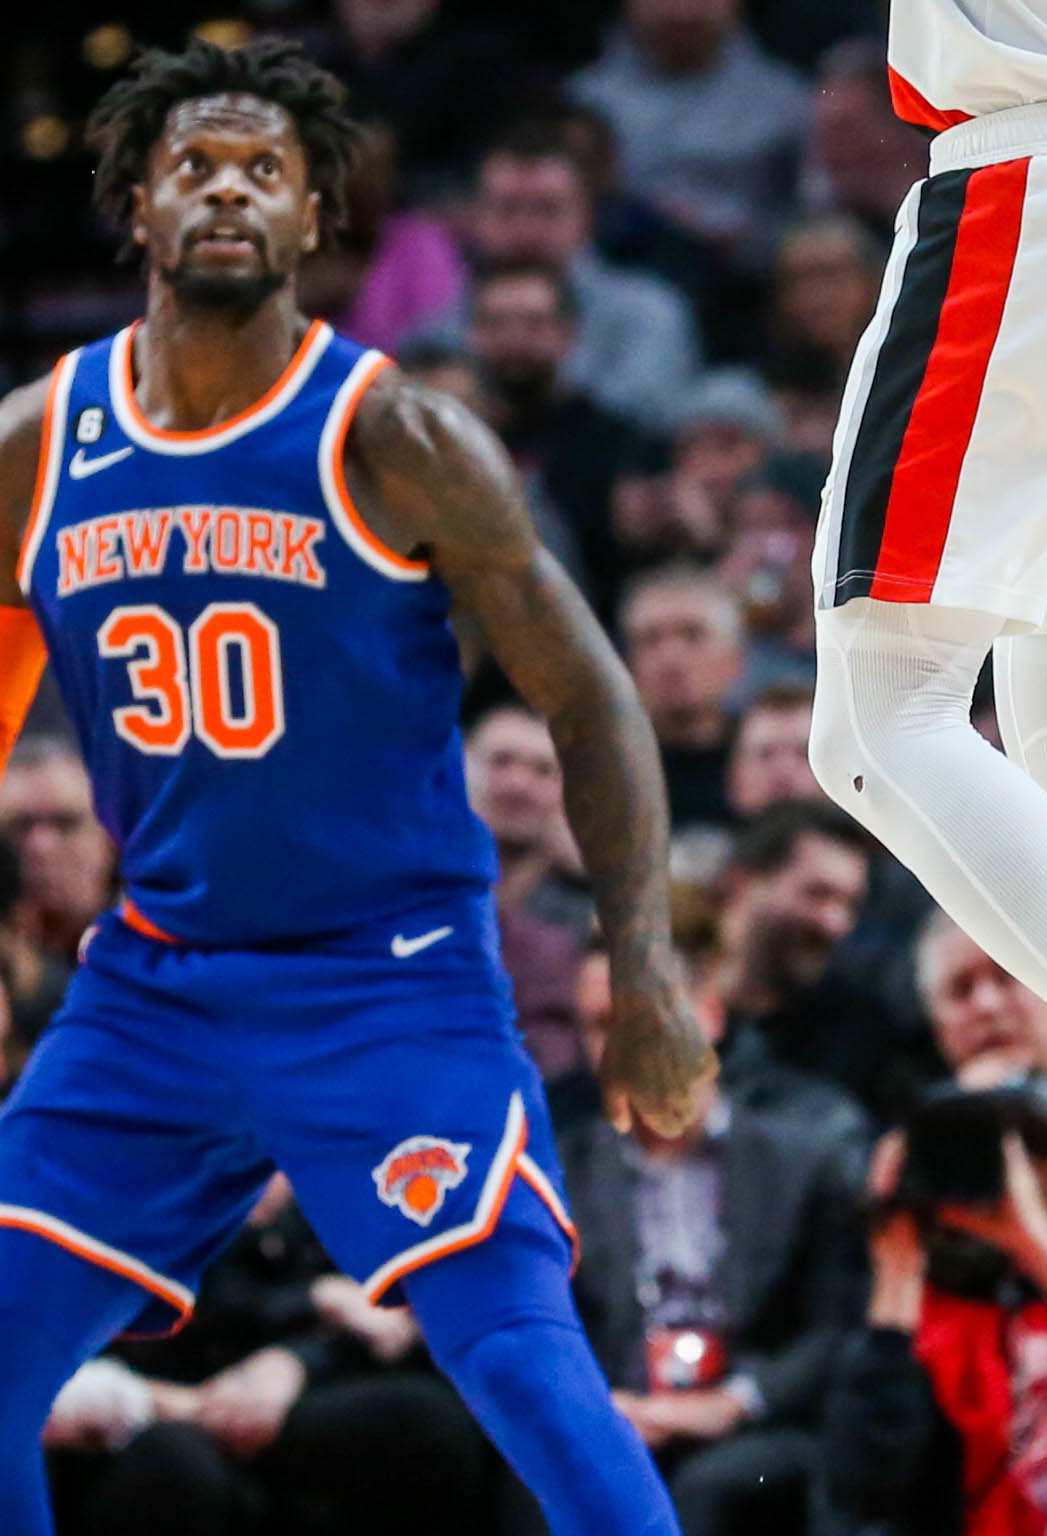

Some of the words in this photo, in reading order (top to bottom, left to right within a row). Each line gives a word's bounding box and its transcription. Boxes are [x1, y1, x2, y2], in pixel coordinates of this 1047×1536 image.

[75, 407, 104, 442] 6
[56, 508, 176, 598] NEW
[178, 504, 327, 590] YORK
[96, 601, 286, 760] 30
